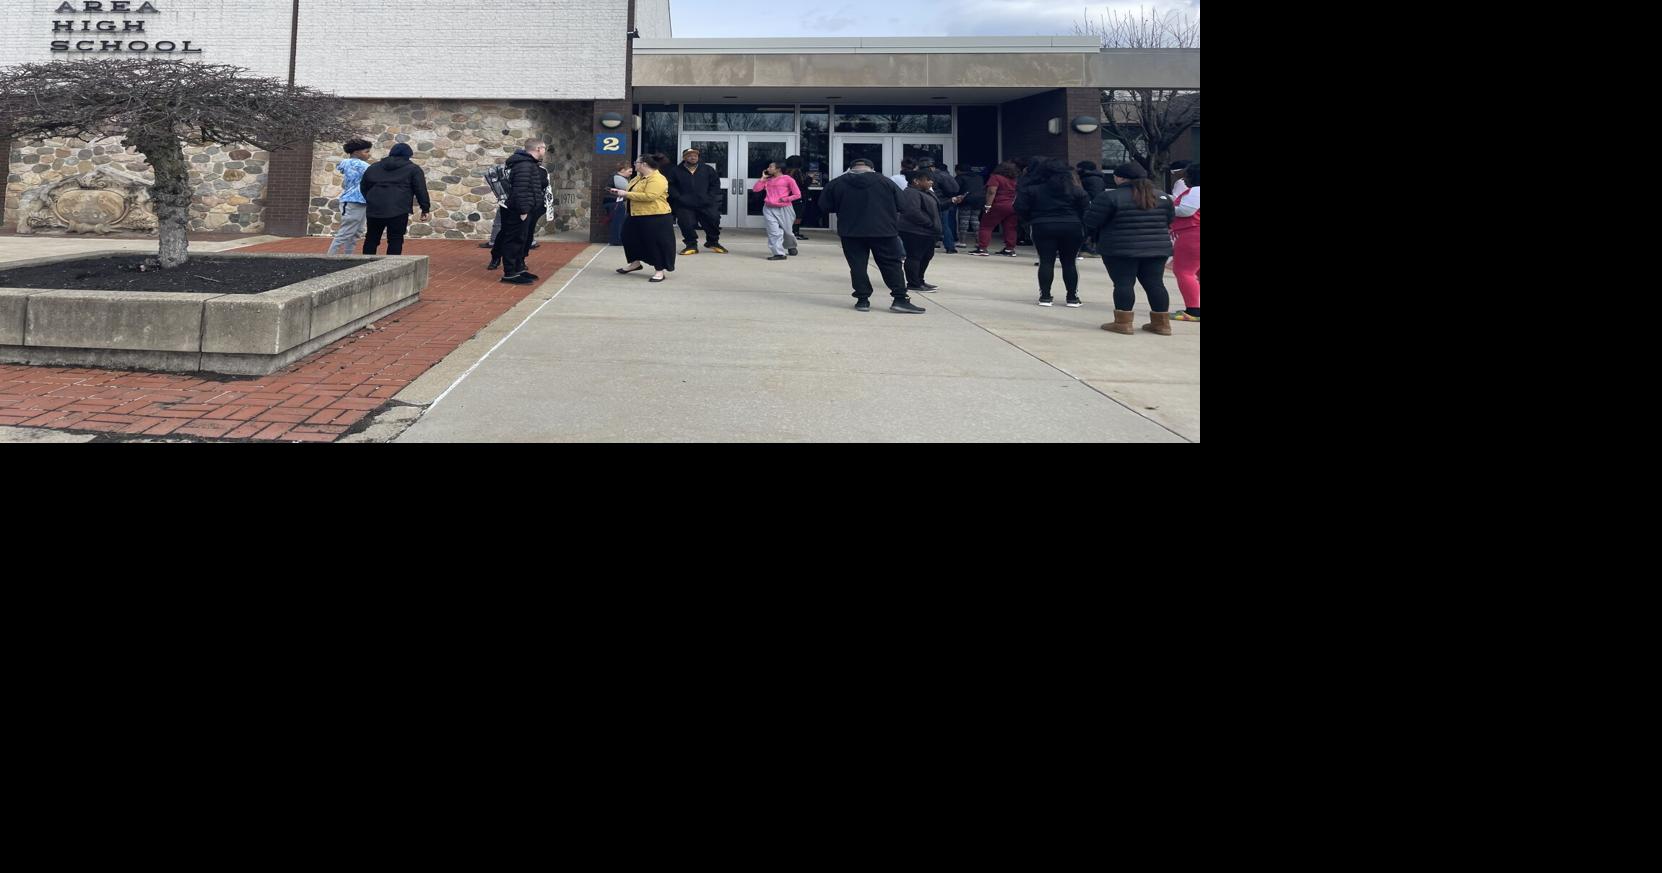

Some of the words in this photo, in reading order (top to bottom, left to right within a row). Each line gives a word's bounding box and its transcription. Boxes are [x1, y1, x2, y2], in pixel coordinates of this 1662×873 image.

[54, 1, 159, 13] AREA
[51, 20, 145, 32] HIGH
[50, 40, 202, 53] SCHOOL
[603, 137, 620, 151] 2
[560, 193, 576, 204] 1970
